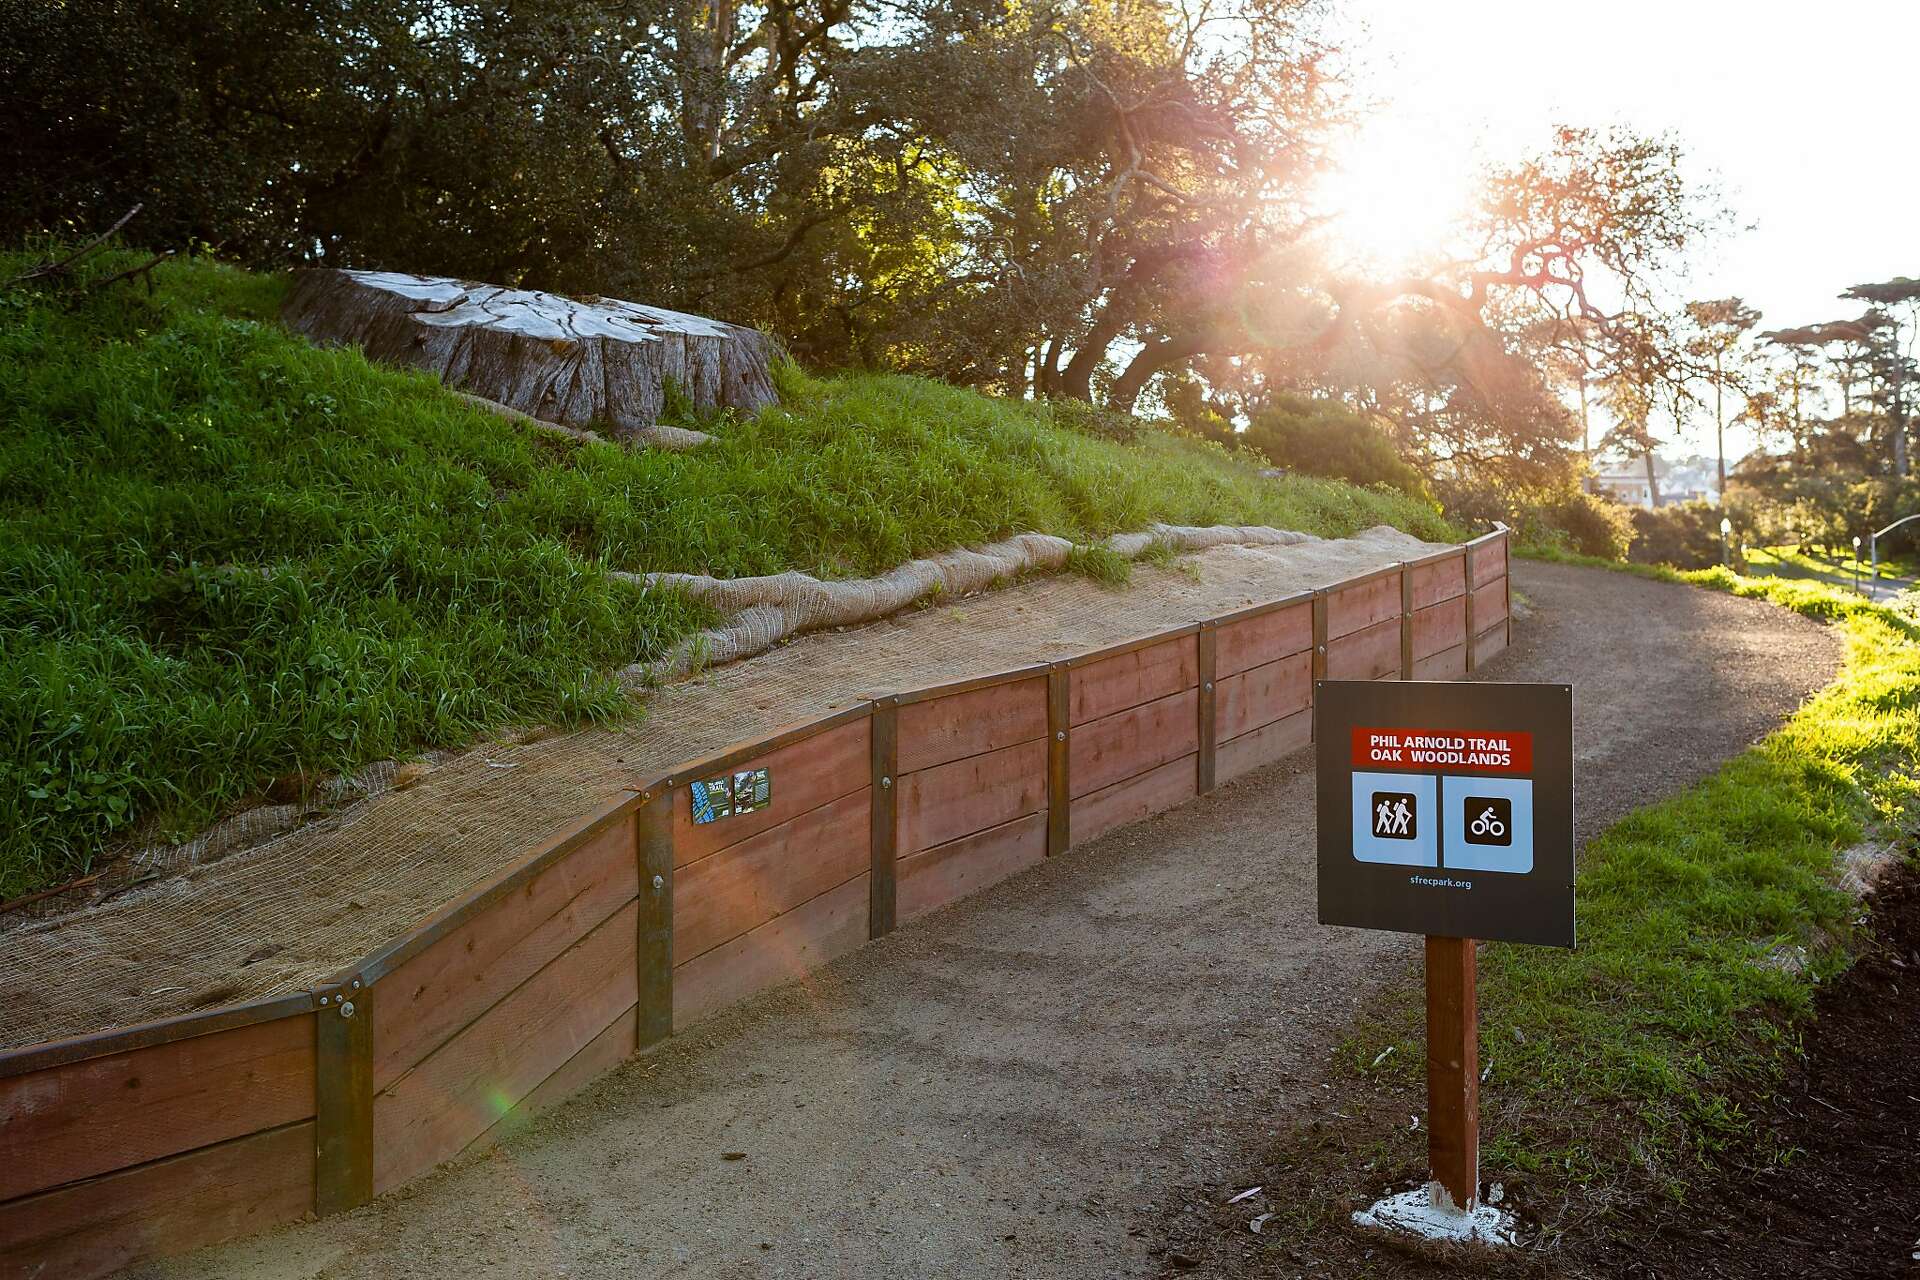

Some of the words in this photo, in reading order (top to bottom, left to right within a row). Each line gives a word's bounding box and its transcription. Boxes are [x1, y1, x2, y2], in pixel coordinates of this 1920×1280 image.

[1370, 734, 1401, 748] PHIL
[1404, 736, 1465, 750] ARNOLD
[1468, 738, 1511, 752] TRAIL
[1370, 749, 1402, 762] OAK
[1411, 750, 1511, 766] WOODLANDS
[1410, 876, 1472, 890] sfrecpark.org
